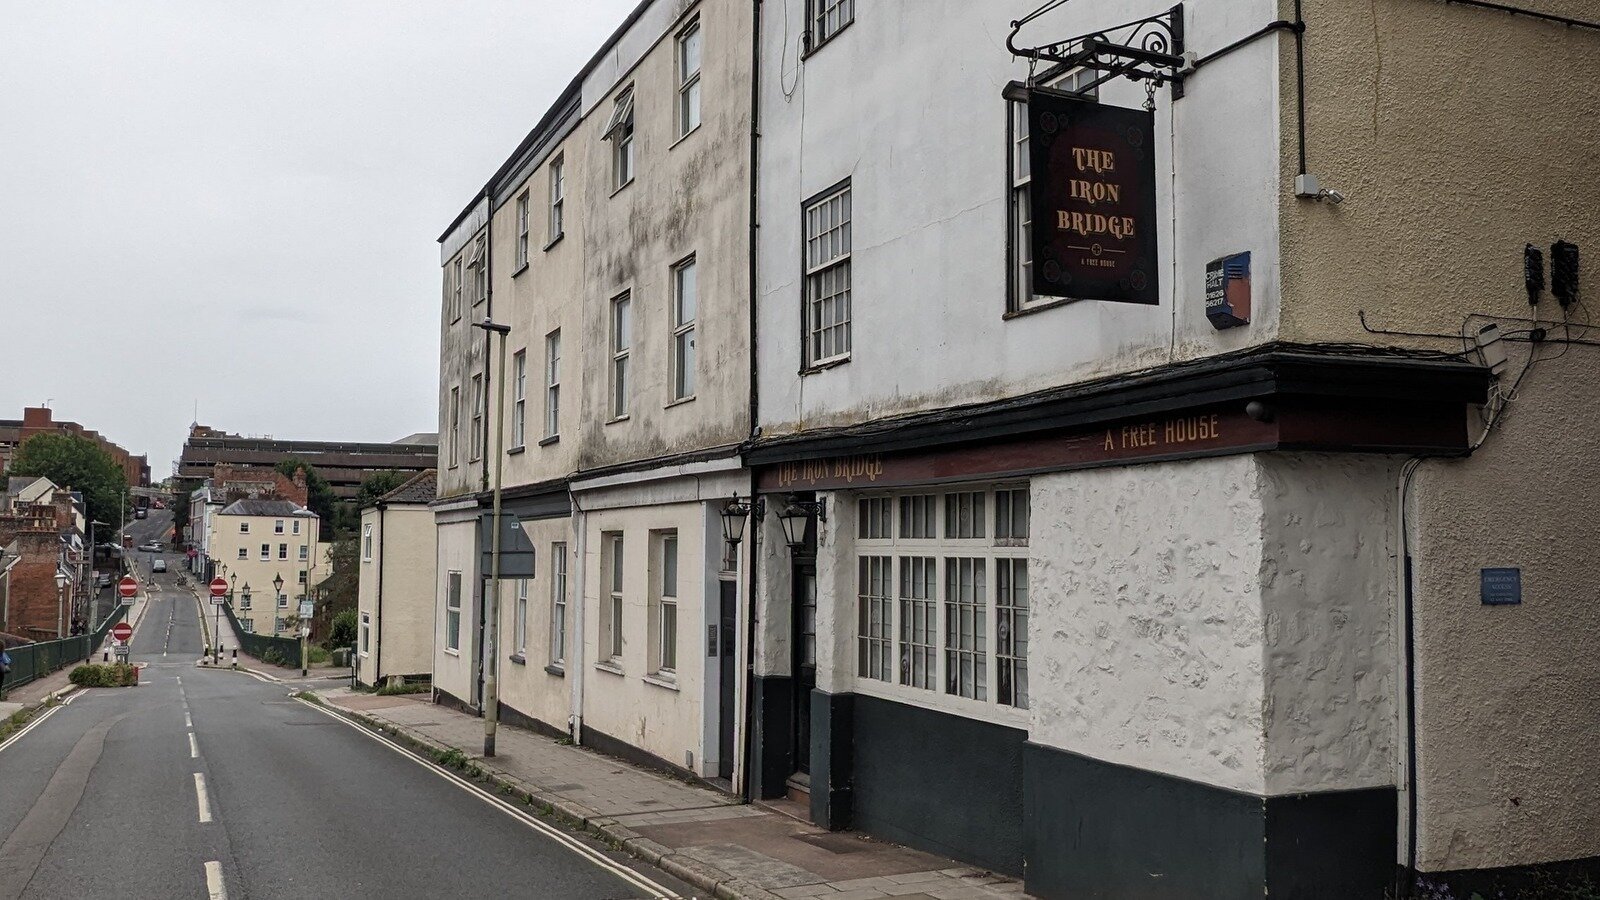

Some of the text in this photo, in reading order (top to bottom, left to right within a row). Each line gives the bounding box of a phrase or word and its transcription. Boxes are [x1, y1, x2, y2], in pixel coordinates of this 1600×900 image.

[1072, 147, 1114, 173] THE
[1069, 179, 1120, 205] IRON
[1057, 210, 1135, 240] BRIDGE
[1086, 258, 1098, 267] FREE
[1104, 414, 1219, 451] A FREE HOUSE
[778, 454, 883, 488] THE IRON BRIDGE
